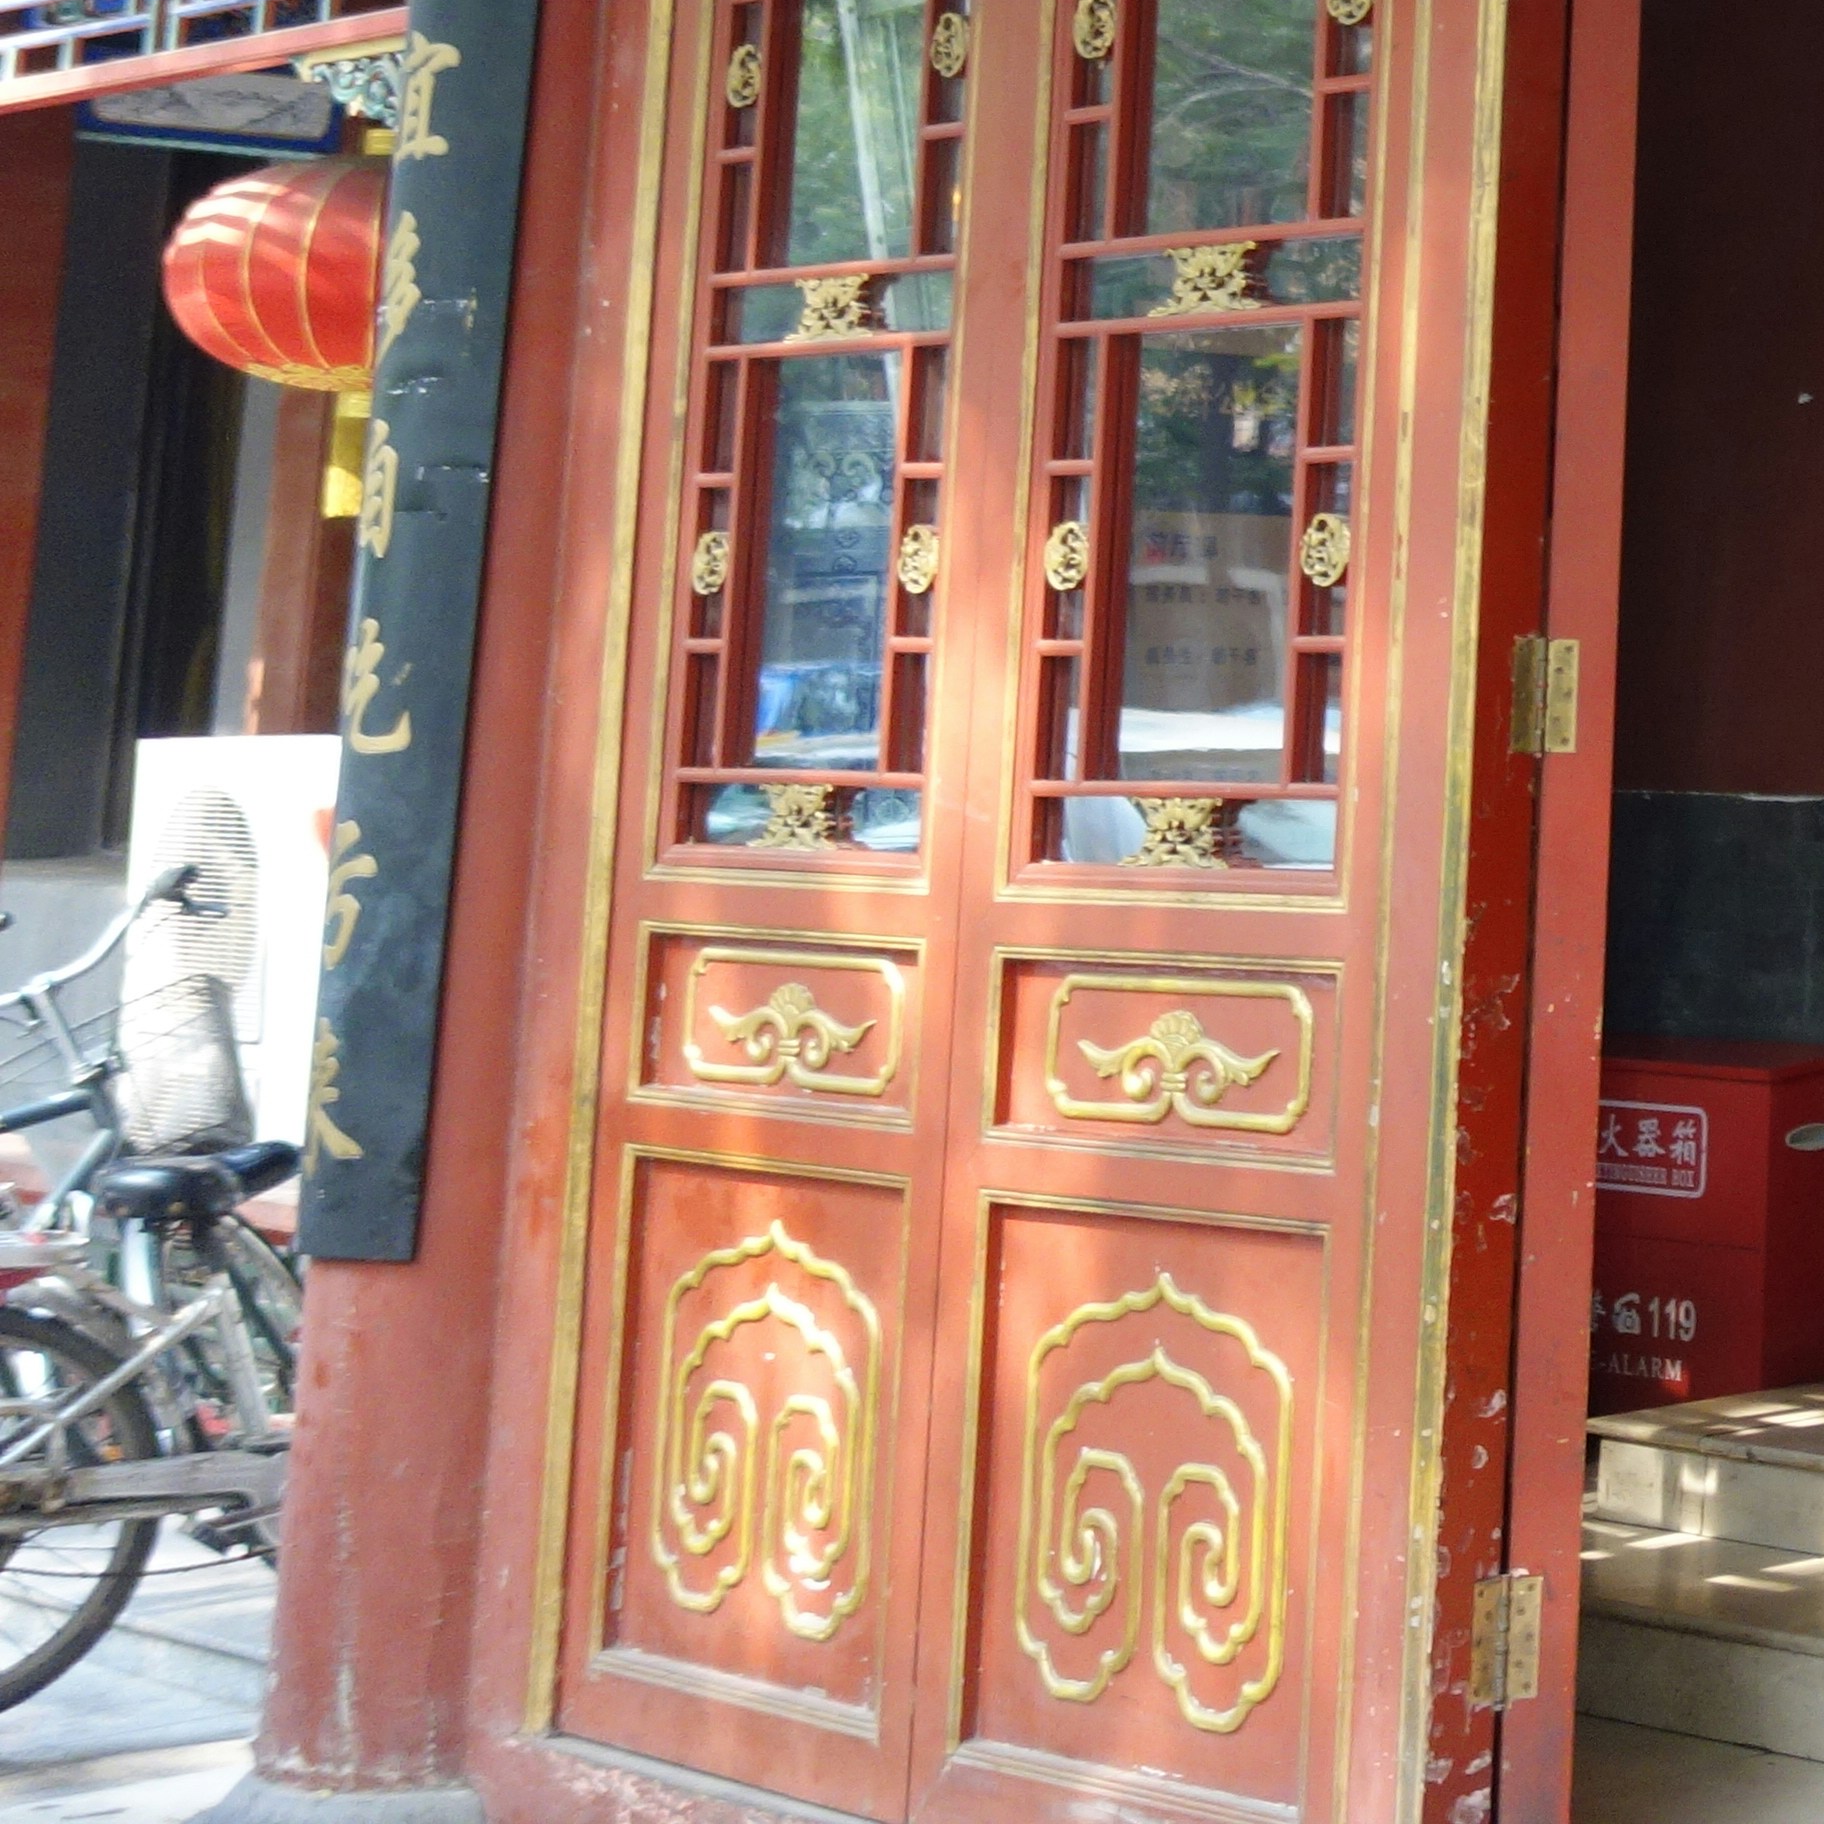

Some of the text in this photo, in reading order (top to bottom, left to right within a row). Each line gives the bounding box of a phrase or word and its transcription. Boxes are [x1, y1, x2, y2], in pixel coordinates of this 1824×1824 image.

[1599, 1113, 1697, 1166] 火器箱
[1671, 1169, 1695, 1187] BOX
[1648, 1296, 1697, 1343] 119
